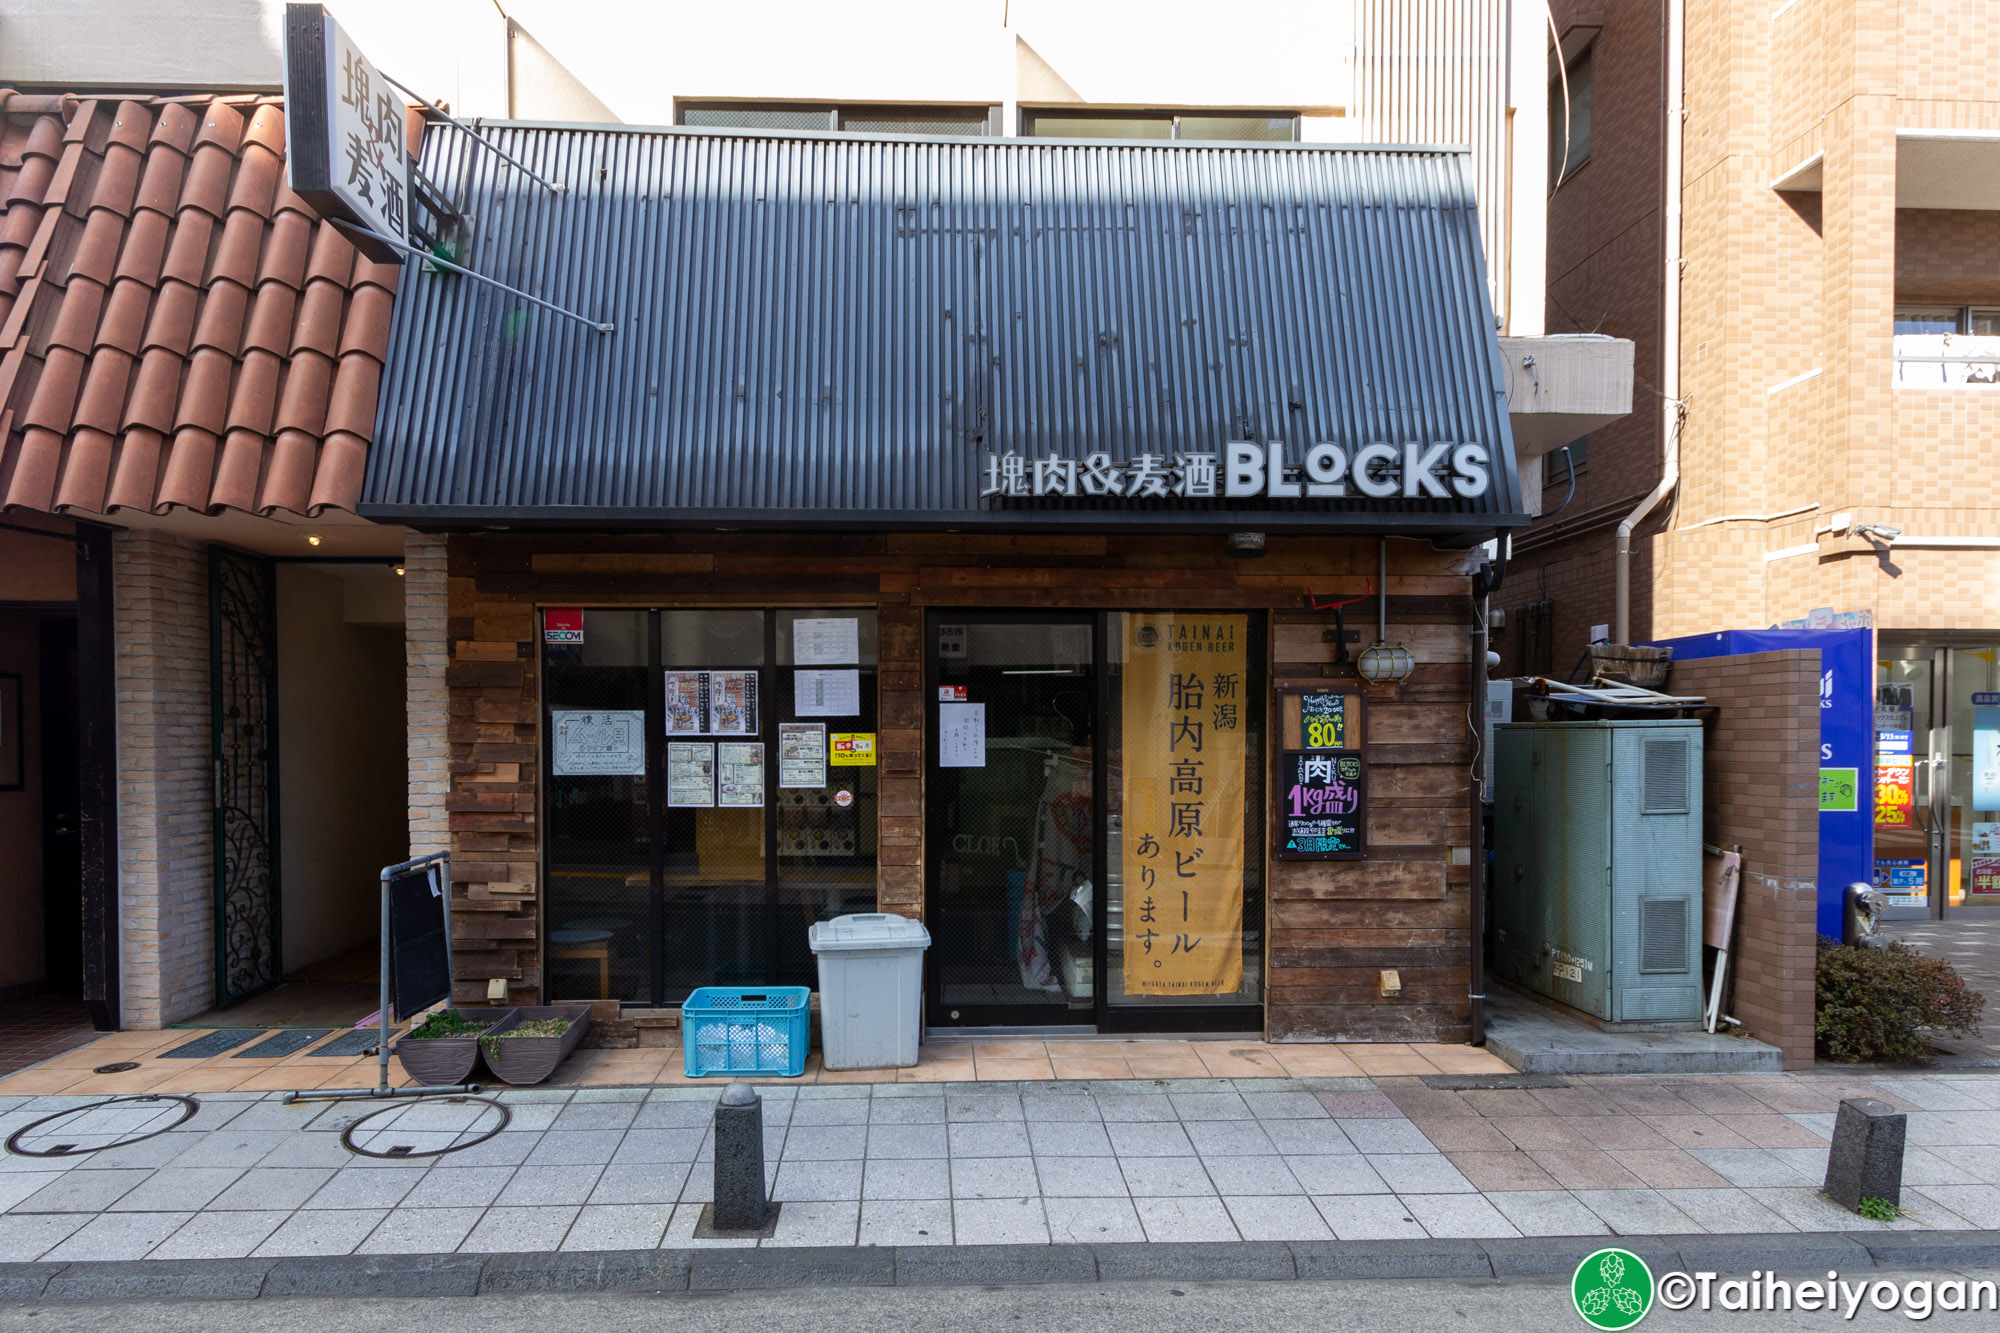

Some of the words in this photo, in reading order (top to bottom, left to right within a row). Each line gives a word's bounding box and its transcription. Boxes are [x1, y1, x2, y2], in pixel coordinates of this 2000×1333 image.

[1224, 440, 1490, 498] BLOCKS
[546, 631, 581, 640] SECOM
[1167, 624, 1235, 640] TAINAI
[1167, 642, 1203, 652] KOGEN
[1207, 642, 1235, 652] BEER
[1212, 672, 1240, 731] 新潟
[1308, 722, 1336, 747] 80
[1304, 755, 1331, 783] 肉
[1167, 672, 1205, 955] 胎内高原ビール
[1135, 832, 1163, 969] あります。
